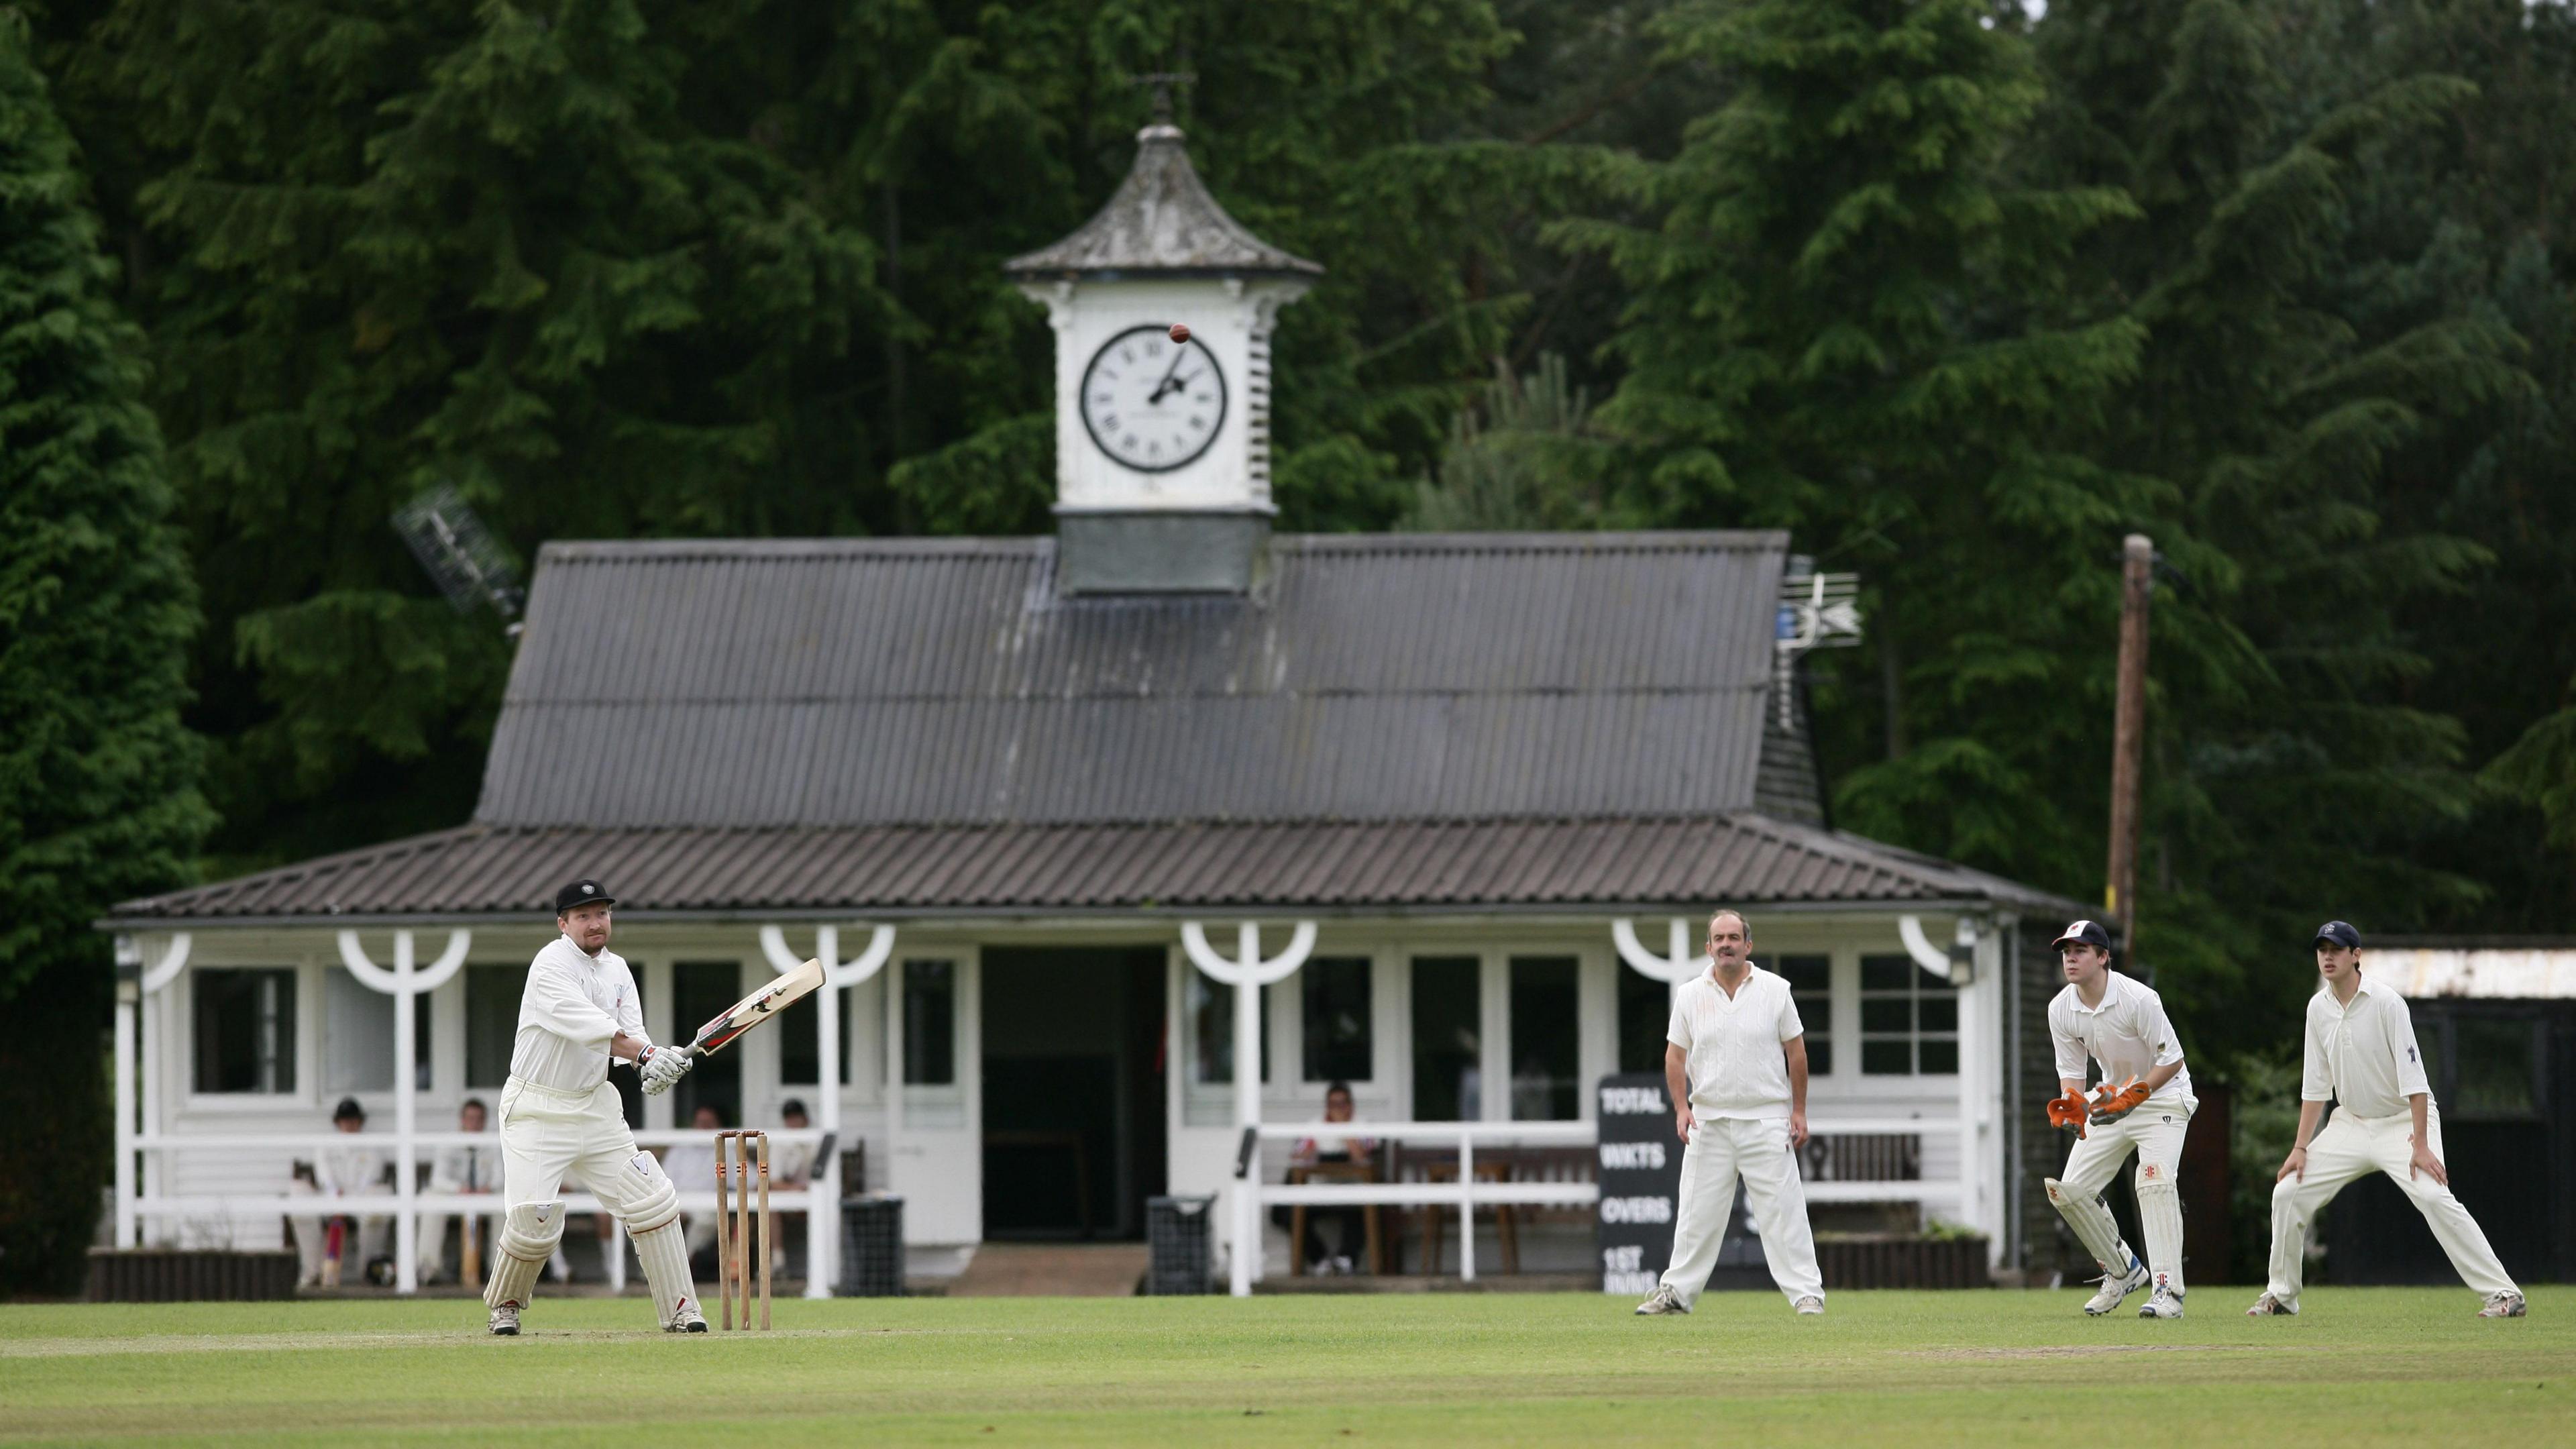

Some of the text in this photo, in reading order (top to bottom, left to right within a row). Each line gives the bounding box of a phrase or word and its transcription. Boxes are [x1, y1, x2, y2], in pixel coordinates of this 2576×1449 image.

[1601, 1087, 1666, 1114] TOTAL
[1600, 1142, 1666, 1169] WKTS
[1600, 1196, 1672, 1224] OVERS
